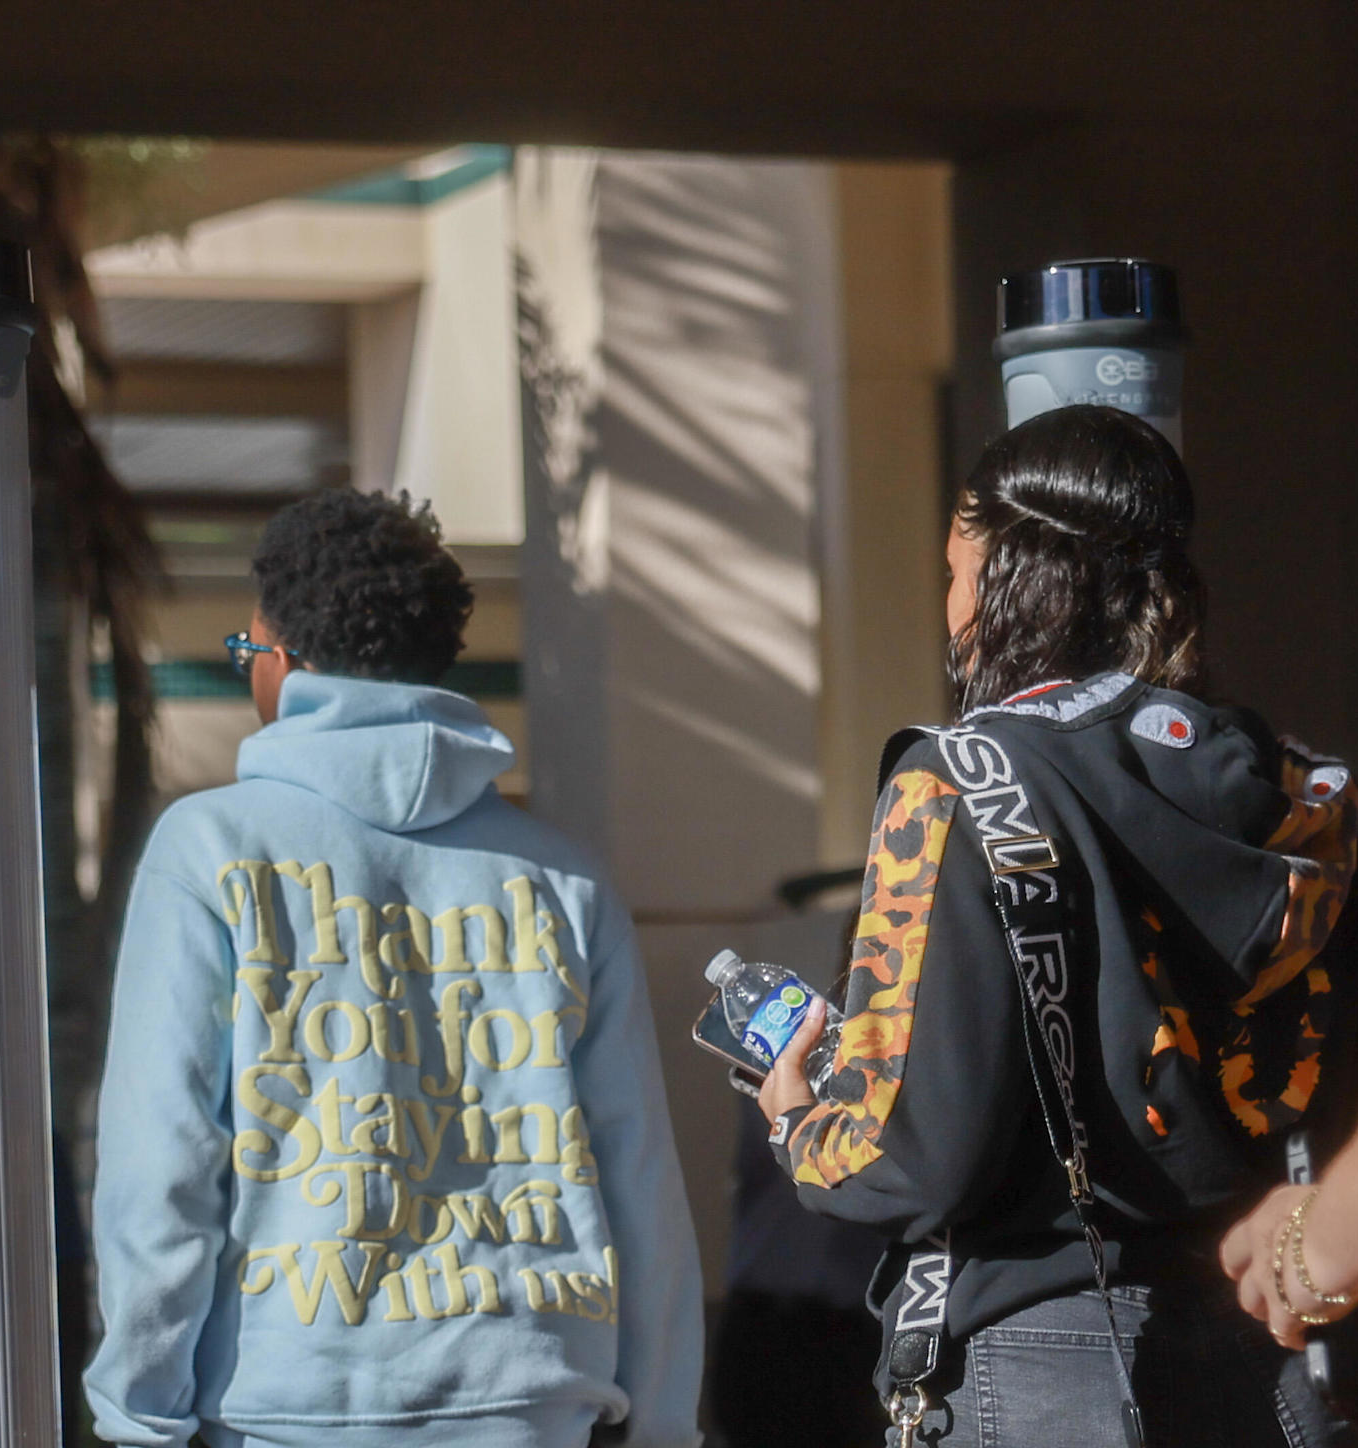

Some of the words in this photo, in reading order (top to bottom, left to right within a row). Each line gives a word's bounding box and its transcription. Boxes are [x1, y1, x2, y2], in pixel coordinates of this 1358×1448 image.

[217, 859, 588, 1000] Thank
[236, 967, 420, 1066] You
[419, 979, 588, 1097] for
[233, 1065, 598, 1185] Staying
[302, 1162, 562, 1245] Down
[242, 1241, 504, 1326] With
